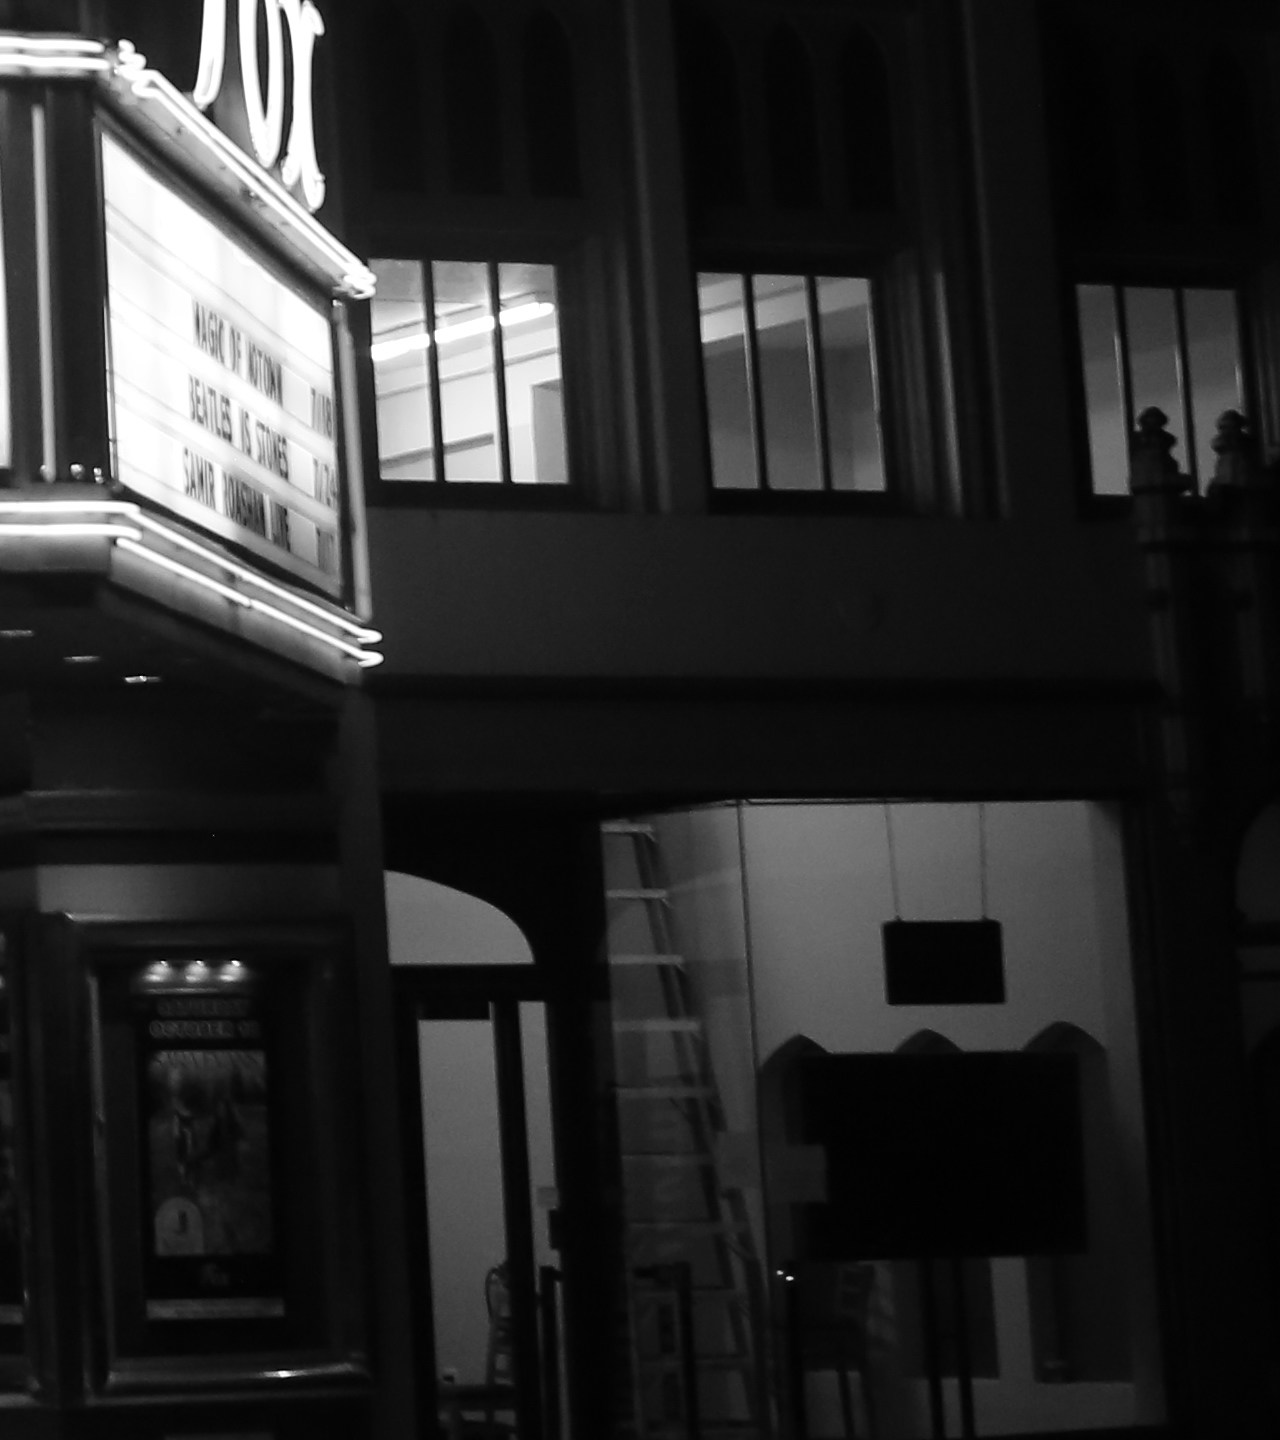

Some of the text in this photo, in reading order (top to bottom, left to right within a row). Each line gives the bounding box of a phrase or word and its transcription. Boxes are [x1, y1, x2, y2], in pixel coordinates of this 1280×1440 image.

[192, 300, 226, 366] MAGIC
[188, 374, 233, 443] BEATLES
[182, 447, 216, 510] SAMIR
